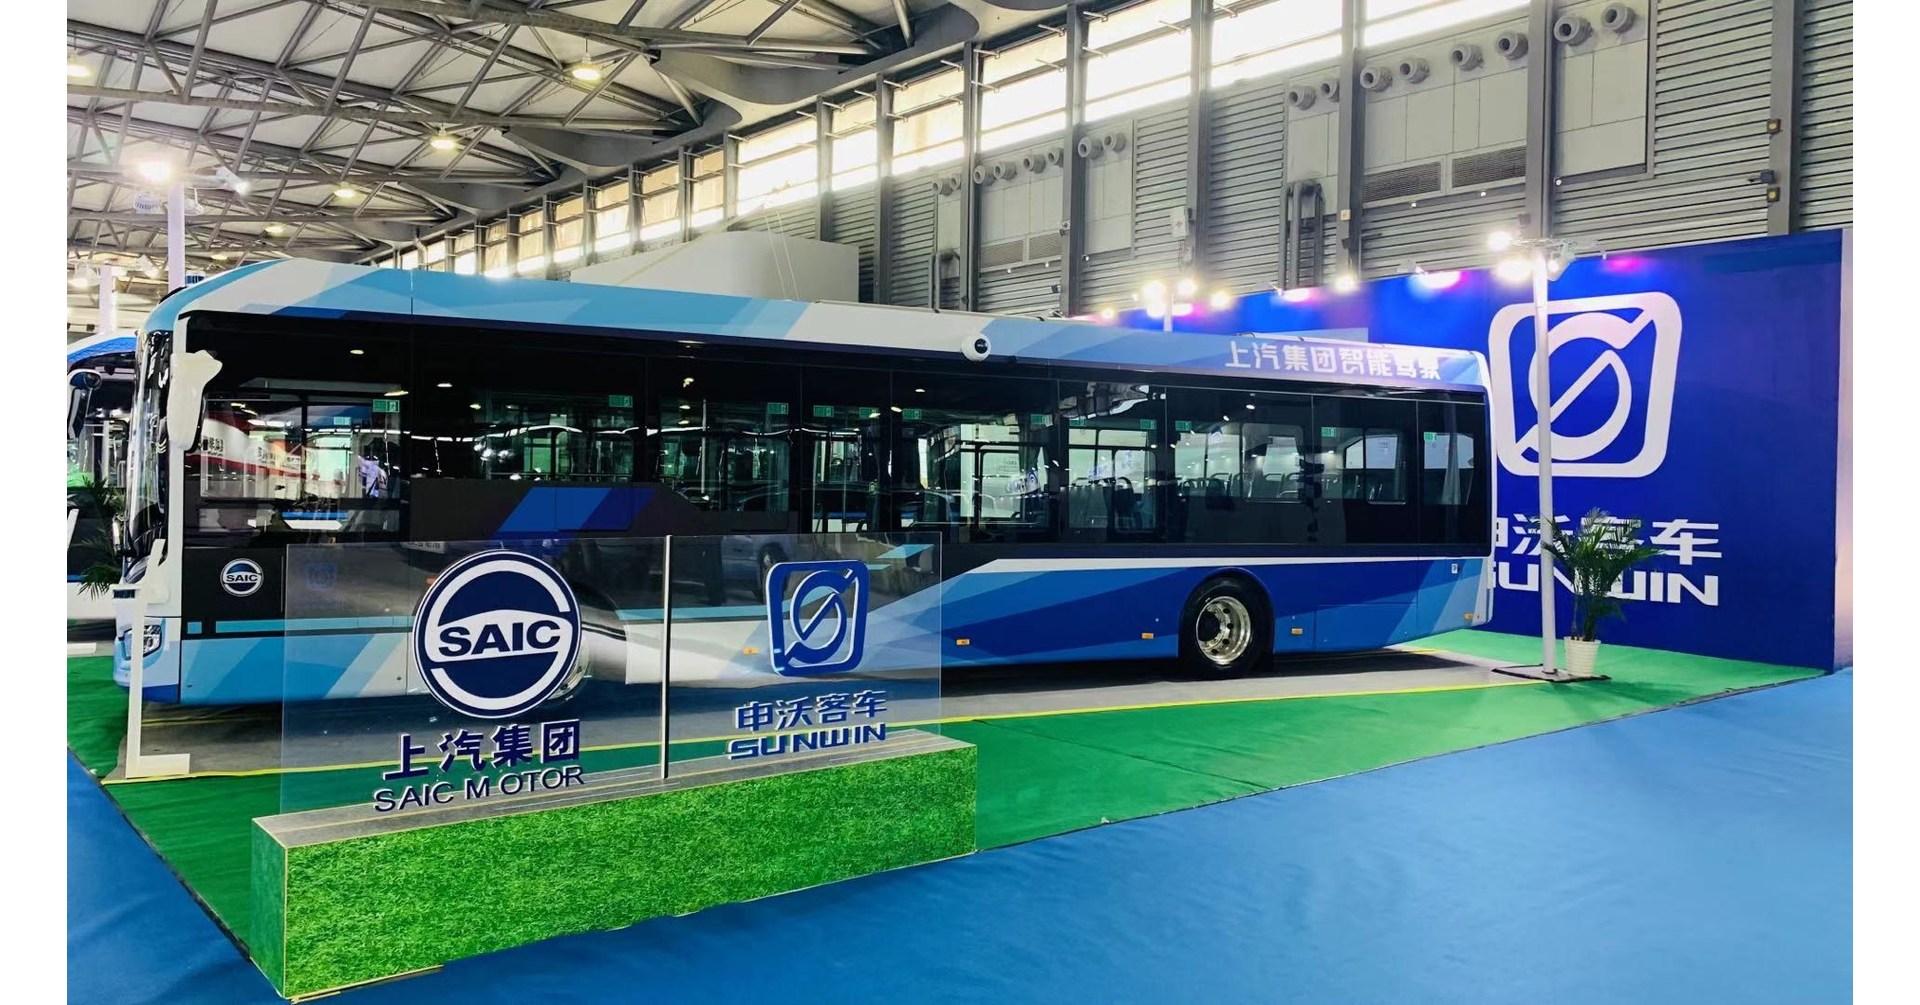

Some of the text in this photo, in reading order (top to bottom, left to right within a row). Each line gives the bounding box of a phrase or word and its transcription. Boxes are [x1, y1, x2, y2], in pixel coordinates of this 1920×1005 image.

[1495, 513, 1722, 566] 沃客车
[226, 574, 259, 583] SAIC
[1493, 561, 1719, 607] UWIN
[438, 620, 561, 657] SAIC
[735, 690, 887, 733] 申沃客车
[383, 719, 580, 780] 上汽集团
[728, 722, 886, 760] SUNWIN
[374, 781, 454, 812] SAIC
